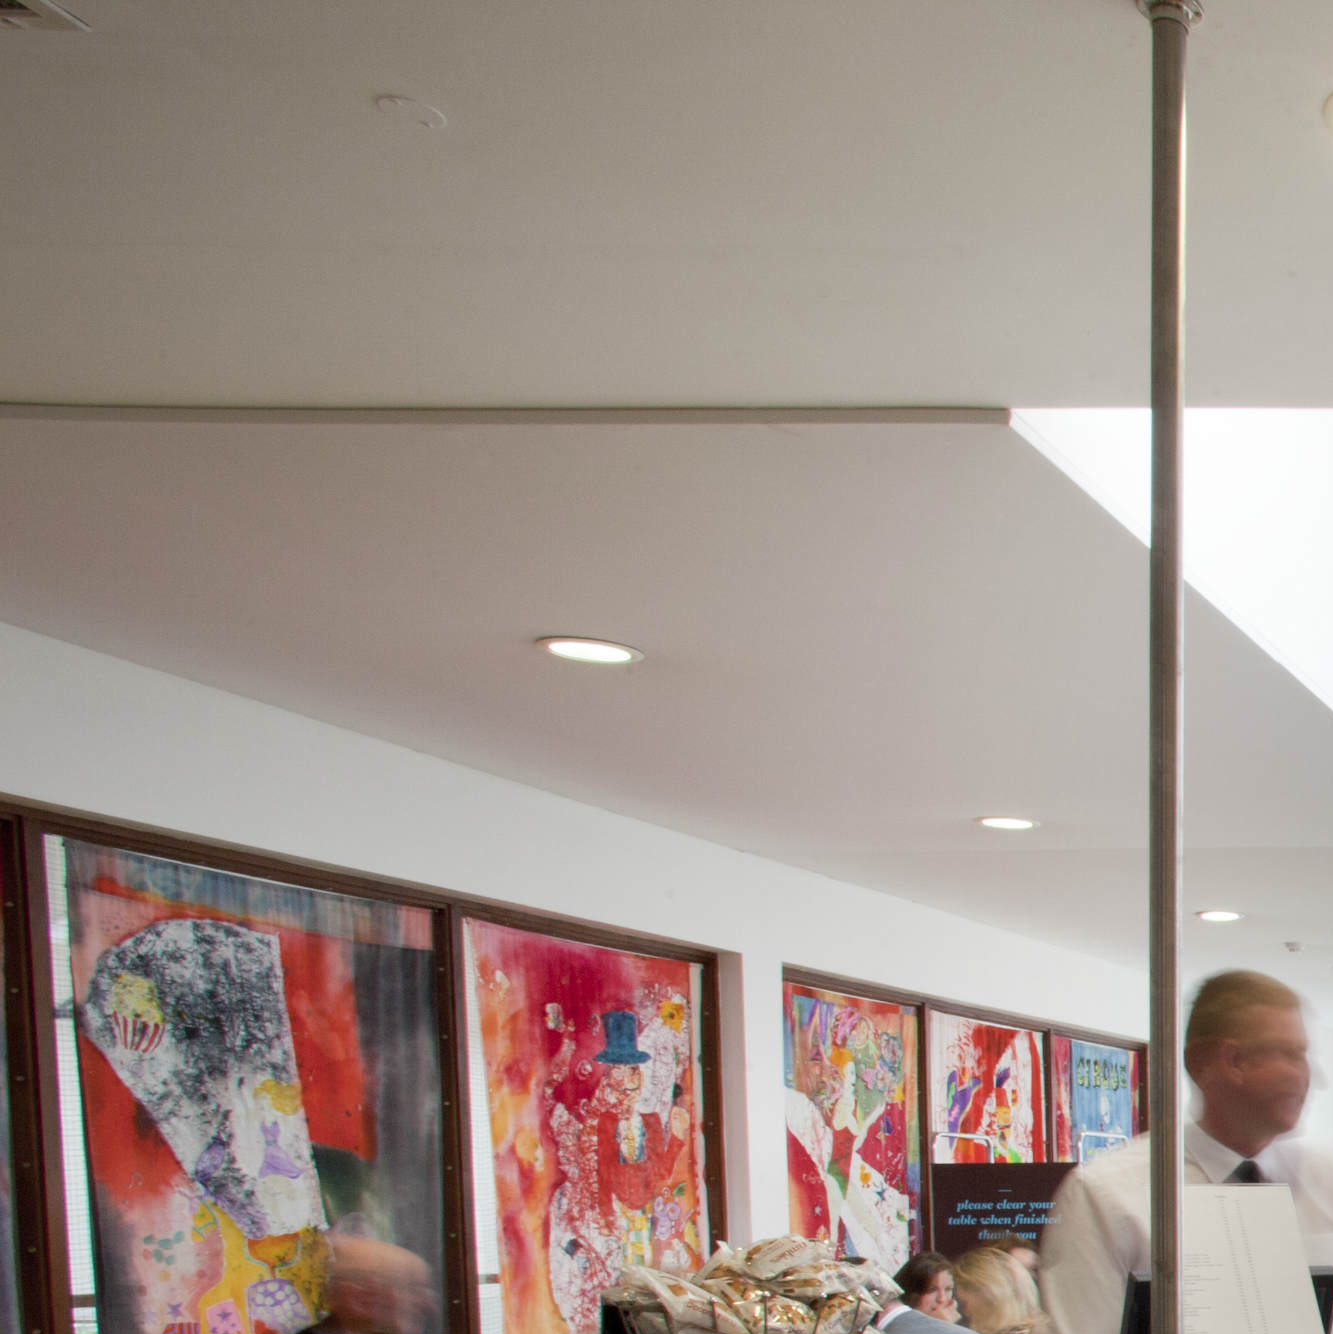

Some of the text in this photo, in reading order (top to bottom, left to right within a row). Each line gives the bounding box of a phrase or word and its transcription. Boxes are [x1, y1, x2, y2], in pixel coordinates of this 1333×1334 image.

[956, 1199, 1056, 1212] please clear your
[948, 1214, 977, 1226] table
[980, 1214, 1012, 1225] when
